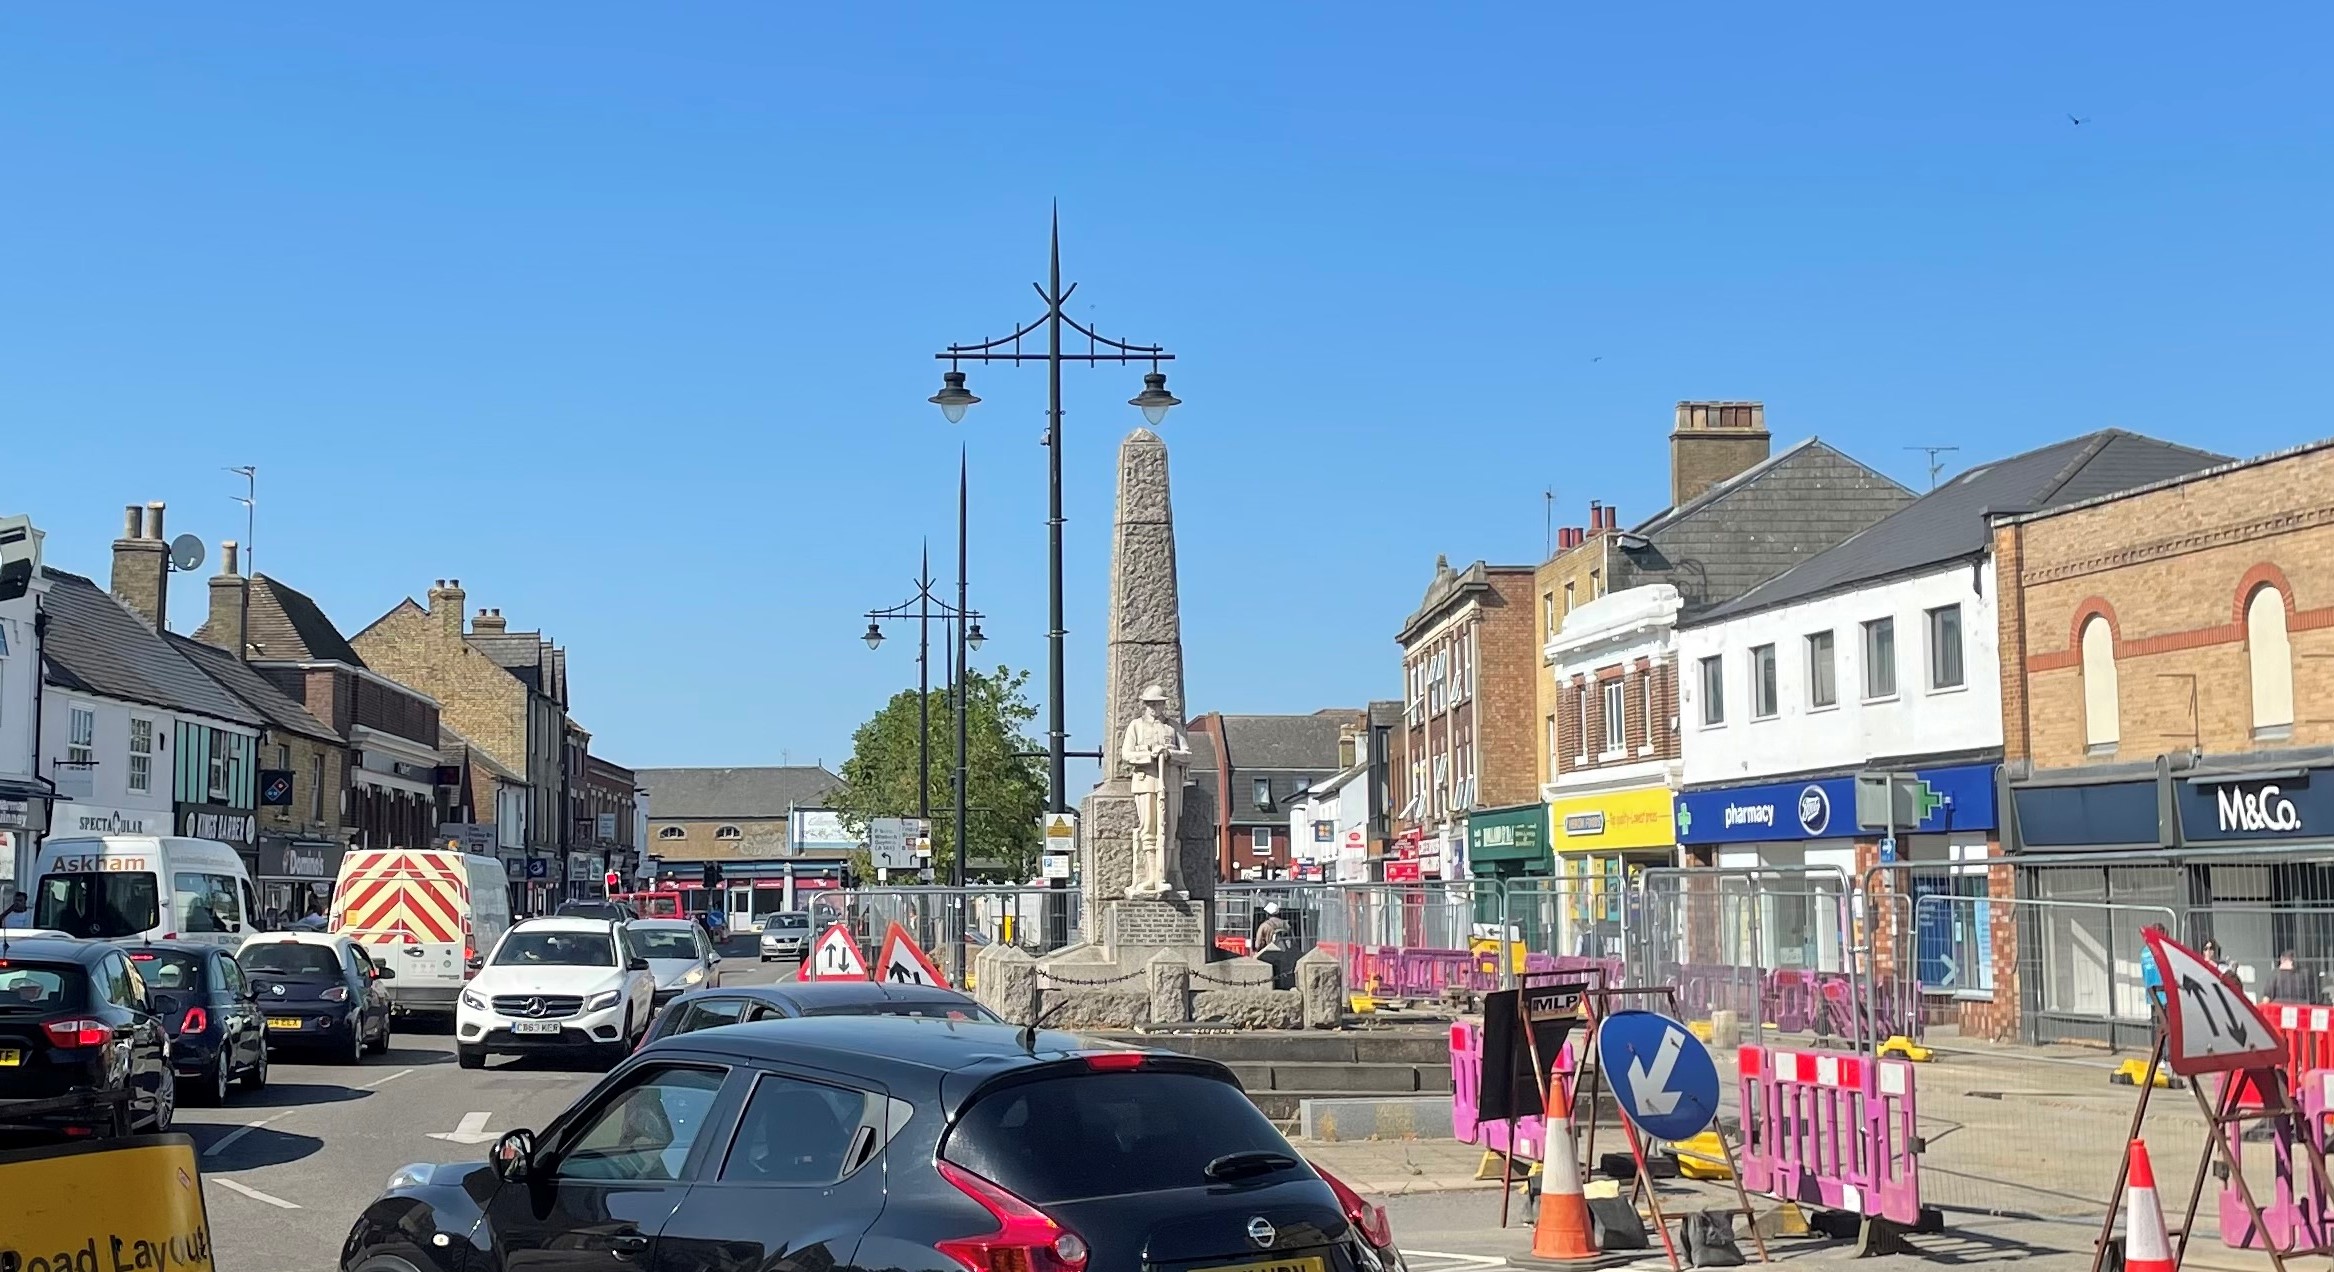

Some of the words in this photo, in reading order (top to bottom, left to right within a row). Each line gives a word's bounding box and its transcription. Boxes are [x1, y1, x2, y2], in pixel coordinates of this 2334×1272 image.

[1724, 802, 1775, 830] pharmacy
[2217, 785, 2302, 833] M&Co.
[79, 810, 143, 837] SPECTACULAR
[51, 854, 145, 873] Askham
[1535, 995, 1578, 1012] MLP
[109, 1225, 208, 1272] Layout
